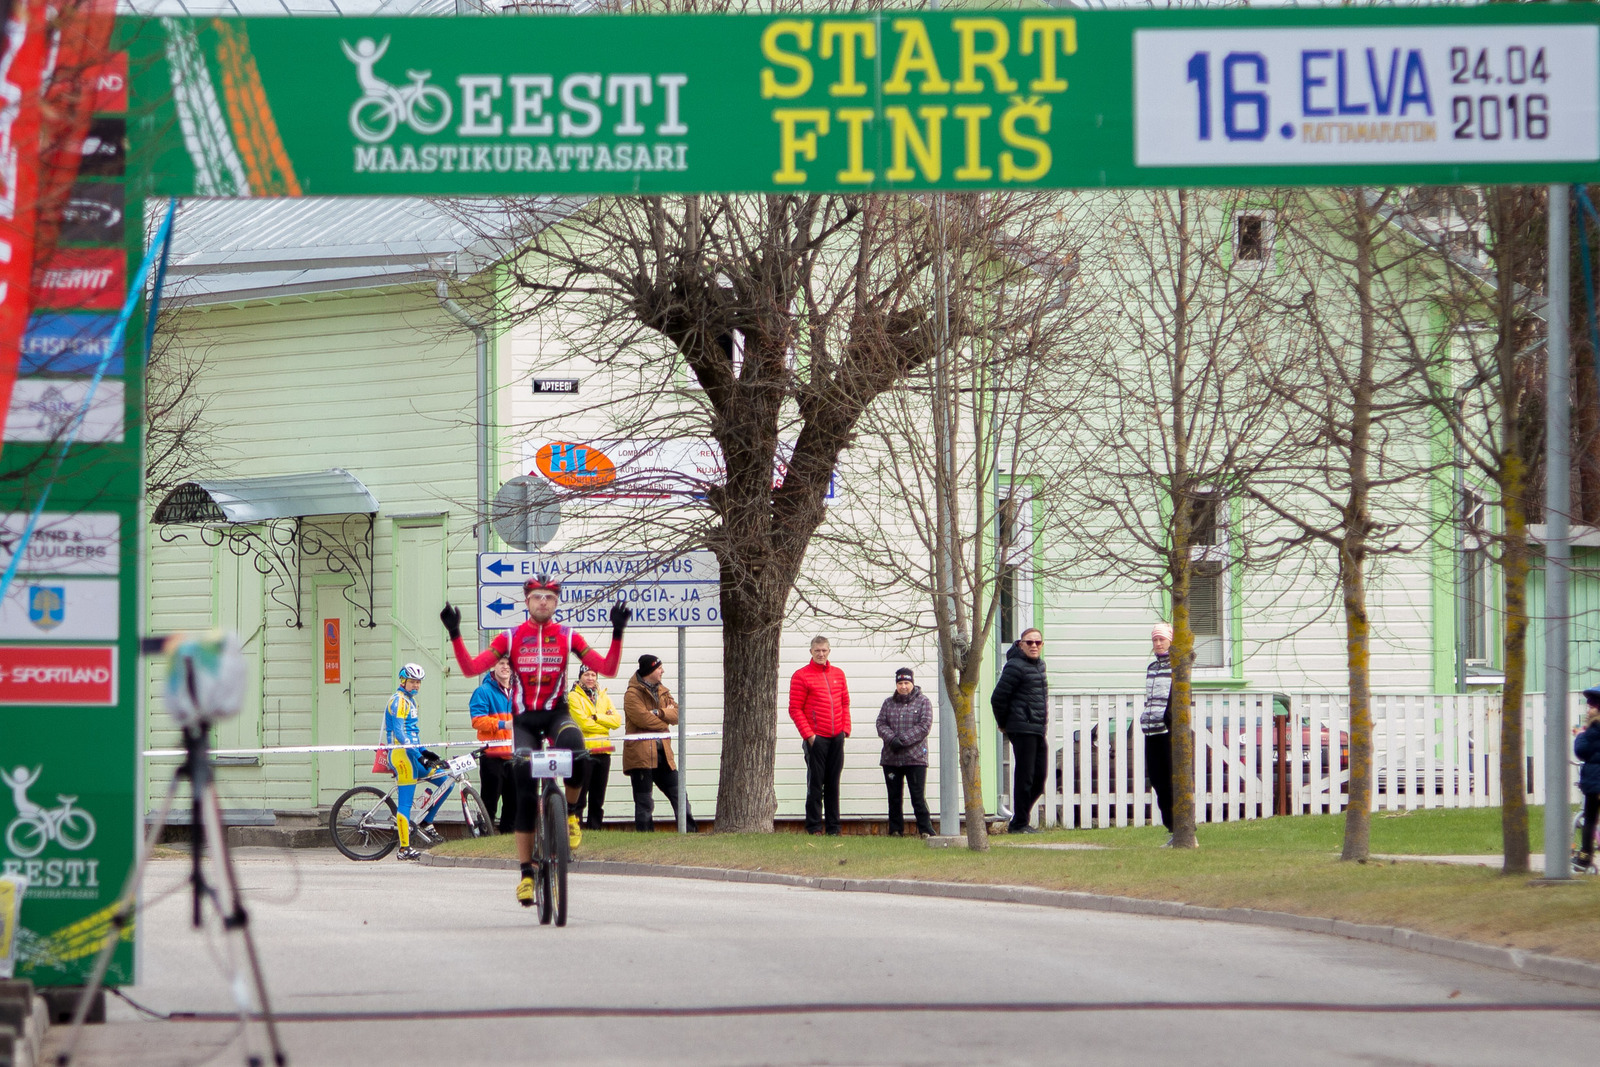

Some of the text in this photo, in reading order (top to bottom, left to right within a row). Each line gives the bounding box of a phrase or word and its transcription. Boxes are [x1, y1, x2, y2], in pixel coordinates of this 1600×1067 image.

[760, 18, 1078, 99] START
[1450, 46, 1551, 84] 24.04
[457, 73, 688, 137] EESTI
[1186, 47, 1435, 142] 16. ELVA
[1302, 121, 1437, 143] RATTAMARATON
[1452, 94, 1549, 140] 2016
[772, 95, 1053, 184] FINIŠ
[353, 144, 688, 173] MAASTIKURATTASARI
[541, 381, 573, 391] APTEEGI
[550, 444, 598, 477] HL
[521, 559, 693, 575] ELVA LINNAVALITSUS
[681, 588, 700, 602] JA
[11, 667, 110, 683] SPORTLAND
[549, 760, 557, 771] 8
